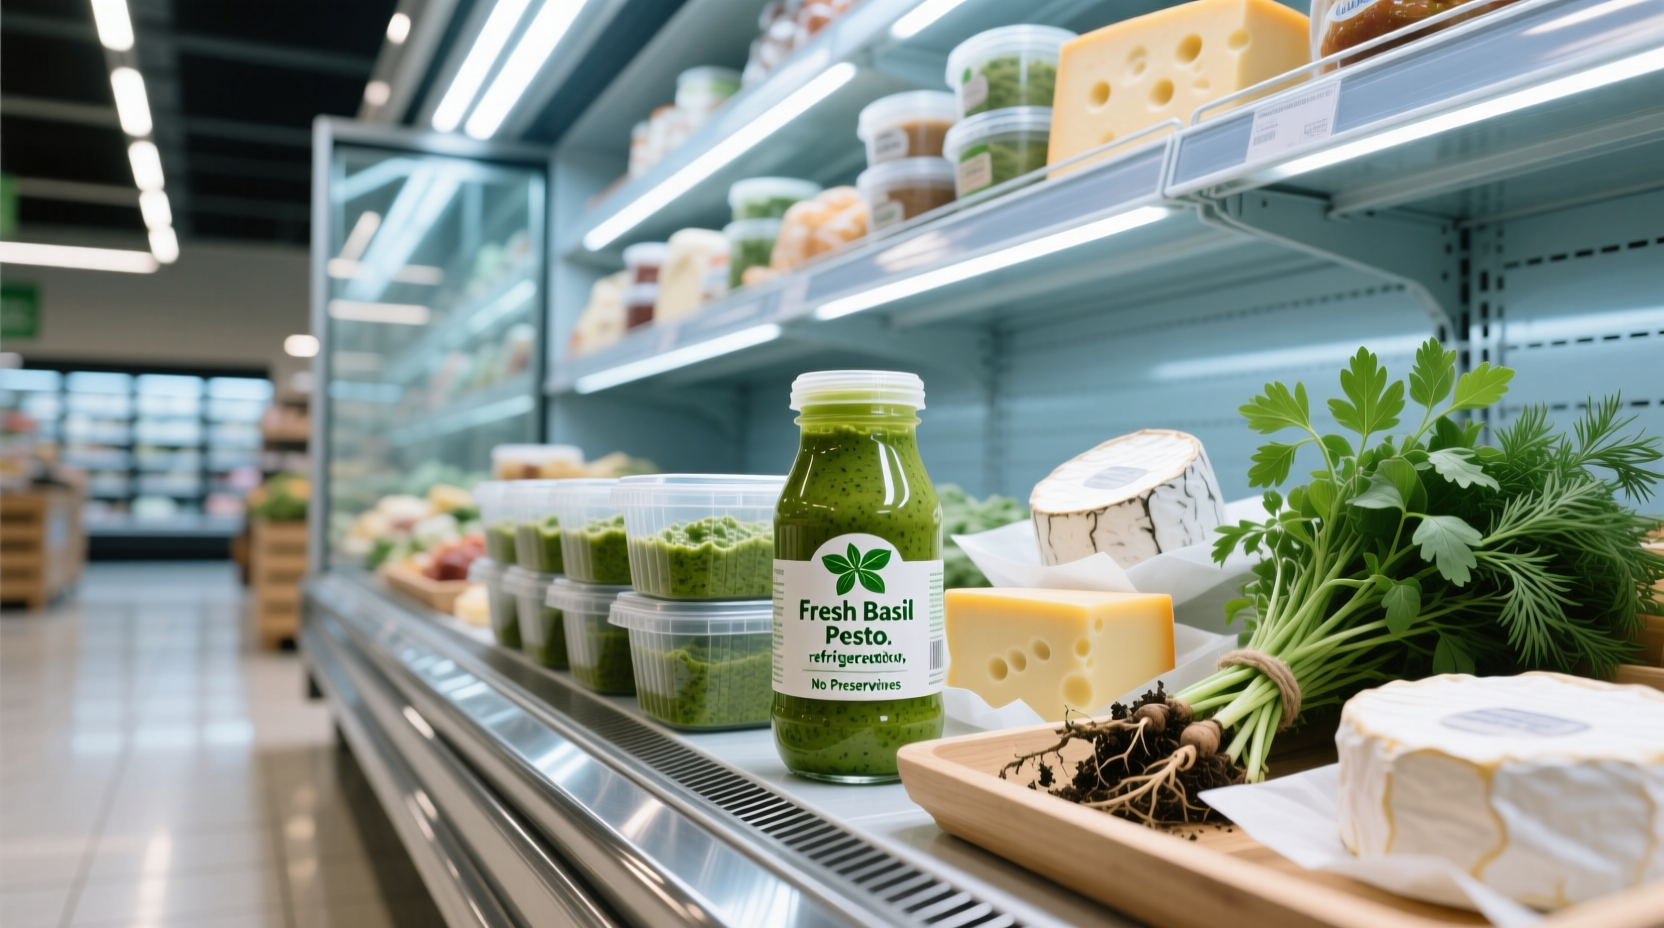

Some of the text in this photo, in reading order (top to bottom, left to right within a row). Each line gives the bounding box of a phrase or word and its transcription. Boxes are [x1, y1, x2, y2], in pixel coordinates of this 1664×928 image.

[800, 599, 913, 621] Fresh Basil
[826, 625, 892, 645] Pesto.
[811, 678, 827, 691] No
